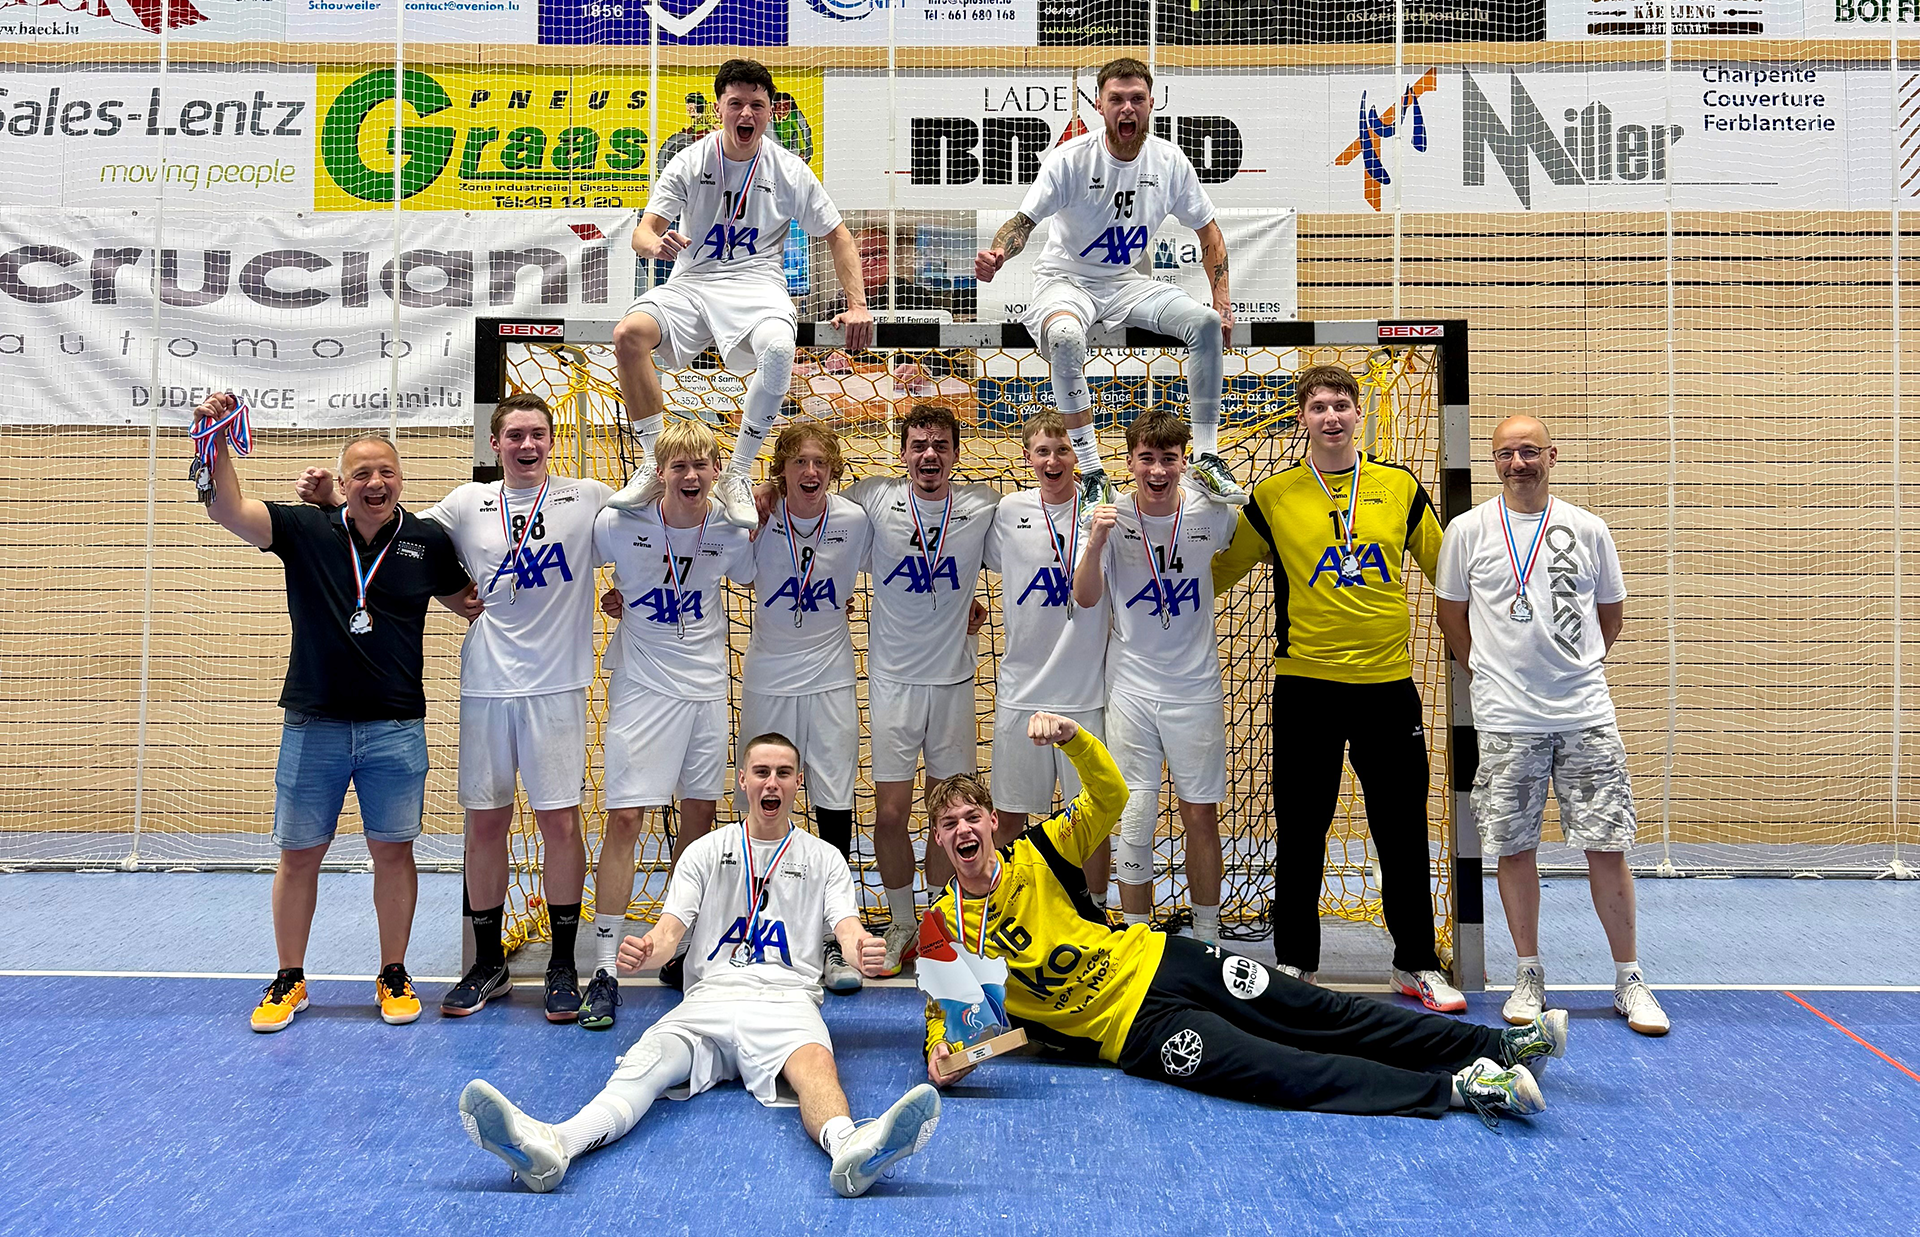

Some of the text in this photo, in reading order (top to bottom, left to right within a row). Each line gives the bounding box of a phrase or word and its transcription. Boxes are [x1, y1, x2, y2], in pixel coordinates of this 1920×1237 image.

[308, 0, 382, 10] Schouweiler
[582, 4, 624, 18] 1856
[1702, 66, 1816, 84] Charpente
[469, 90, 648, 110] PNEUS
[1703, 90, 1825, 108] Couverture
[1703, 114, 1836, 132] Ferblanterie
[100, 158, 296, 191] moving people
[1114, 190, 1136, 220] 95
[1079, 225, 1149, 265] AXA
[0, 223, 609, 309] cruciani
[500, 325, 558, 335] BENZ
[1378, 326, 1439, 337] BENZ
[132, 385, 296, 410] DUDENGE
[327, 386, 463, 410] cruciani.lu
[489, 542, 573, 594] AXA
[883, 555, 961, 594] AXA
[1154, 543, 1185, 574] 14
[764, 576, 841, 612] AXA
[1016, 566, 1075, 607] AX
[1125, 577, 1201, 617] AXA
[1545, 524, 1583, 661] OAKLEY
[629, 587, 704, 624] AXA
[991, 916, 1033, 959] 16
